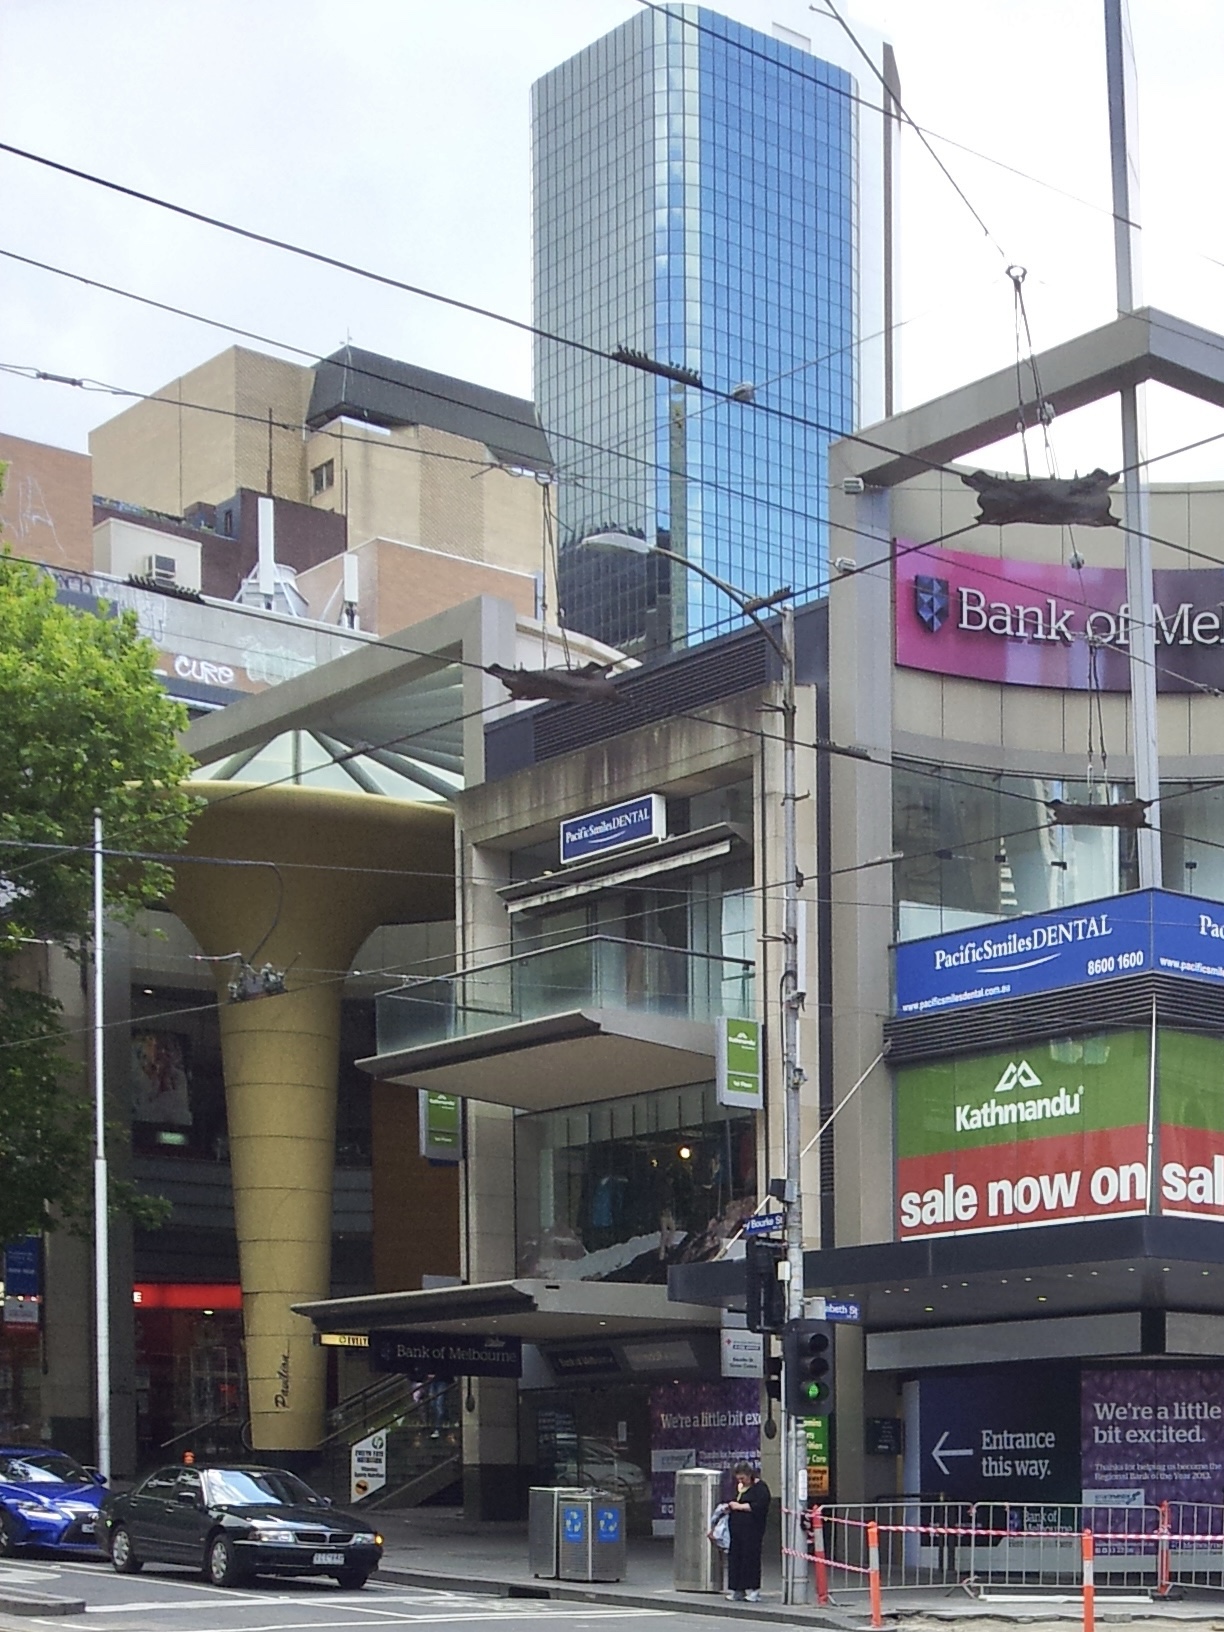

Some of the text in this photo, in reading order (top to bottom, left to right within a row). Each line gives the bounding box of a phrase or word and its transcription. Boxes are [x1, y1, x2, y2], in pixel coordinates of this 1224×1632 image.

[958, 587, 1075, 642] Bank
[1086, 603, 1131, 645] of
[934, 914, 1113, 970] PacificSmilesDENTAL
[1087, 950, 1144, 976] 8600 1600
[902, 984, 1011, 1012] www.pacificsmilesdental.com.au
[955, 1087, 1081, 1132] Kathmandu
[901, 1161, 1146, 1228] sale now on
[849, 1305, 858, 1315] St
[397, 1344, 517, 1363] Bank of Melbourne
[660, 1413, 692, 1429] We're
[693, 1415, 700, 1427] a
[701, 1411, 727, 1427] little
[728, 1410, 744, 1426] bit
[1093, 1402, 1222, 1420] We're a little
[981, 1430, 1055, 1450] Entrance
[1093, 1425, 1206, 1444] bit excited.
[982, 1456, 1052, 1480] this way.
[1048, 1510, 1058, 1523] of
